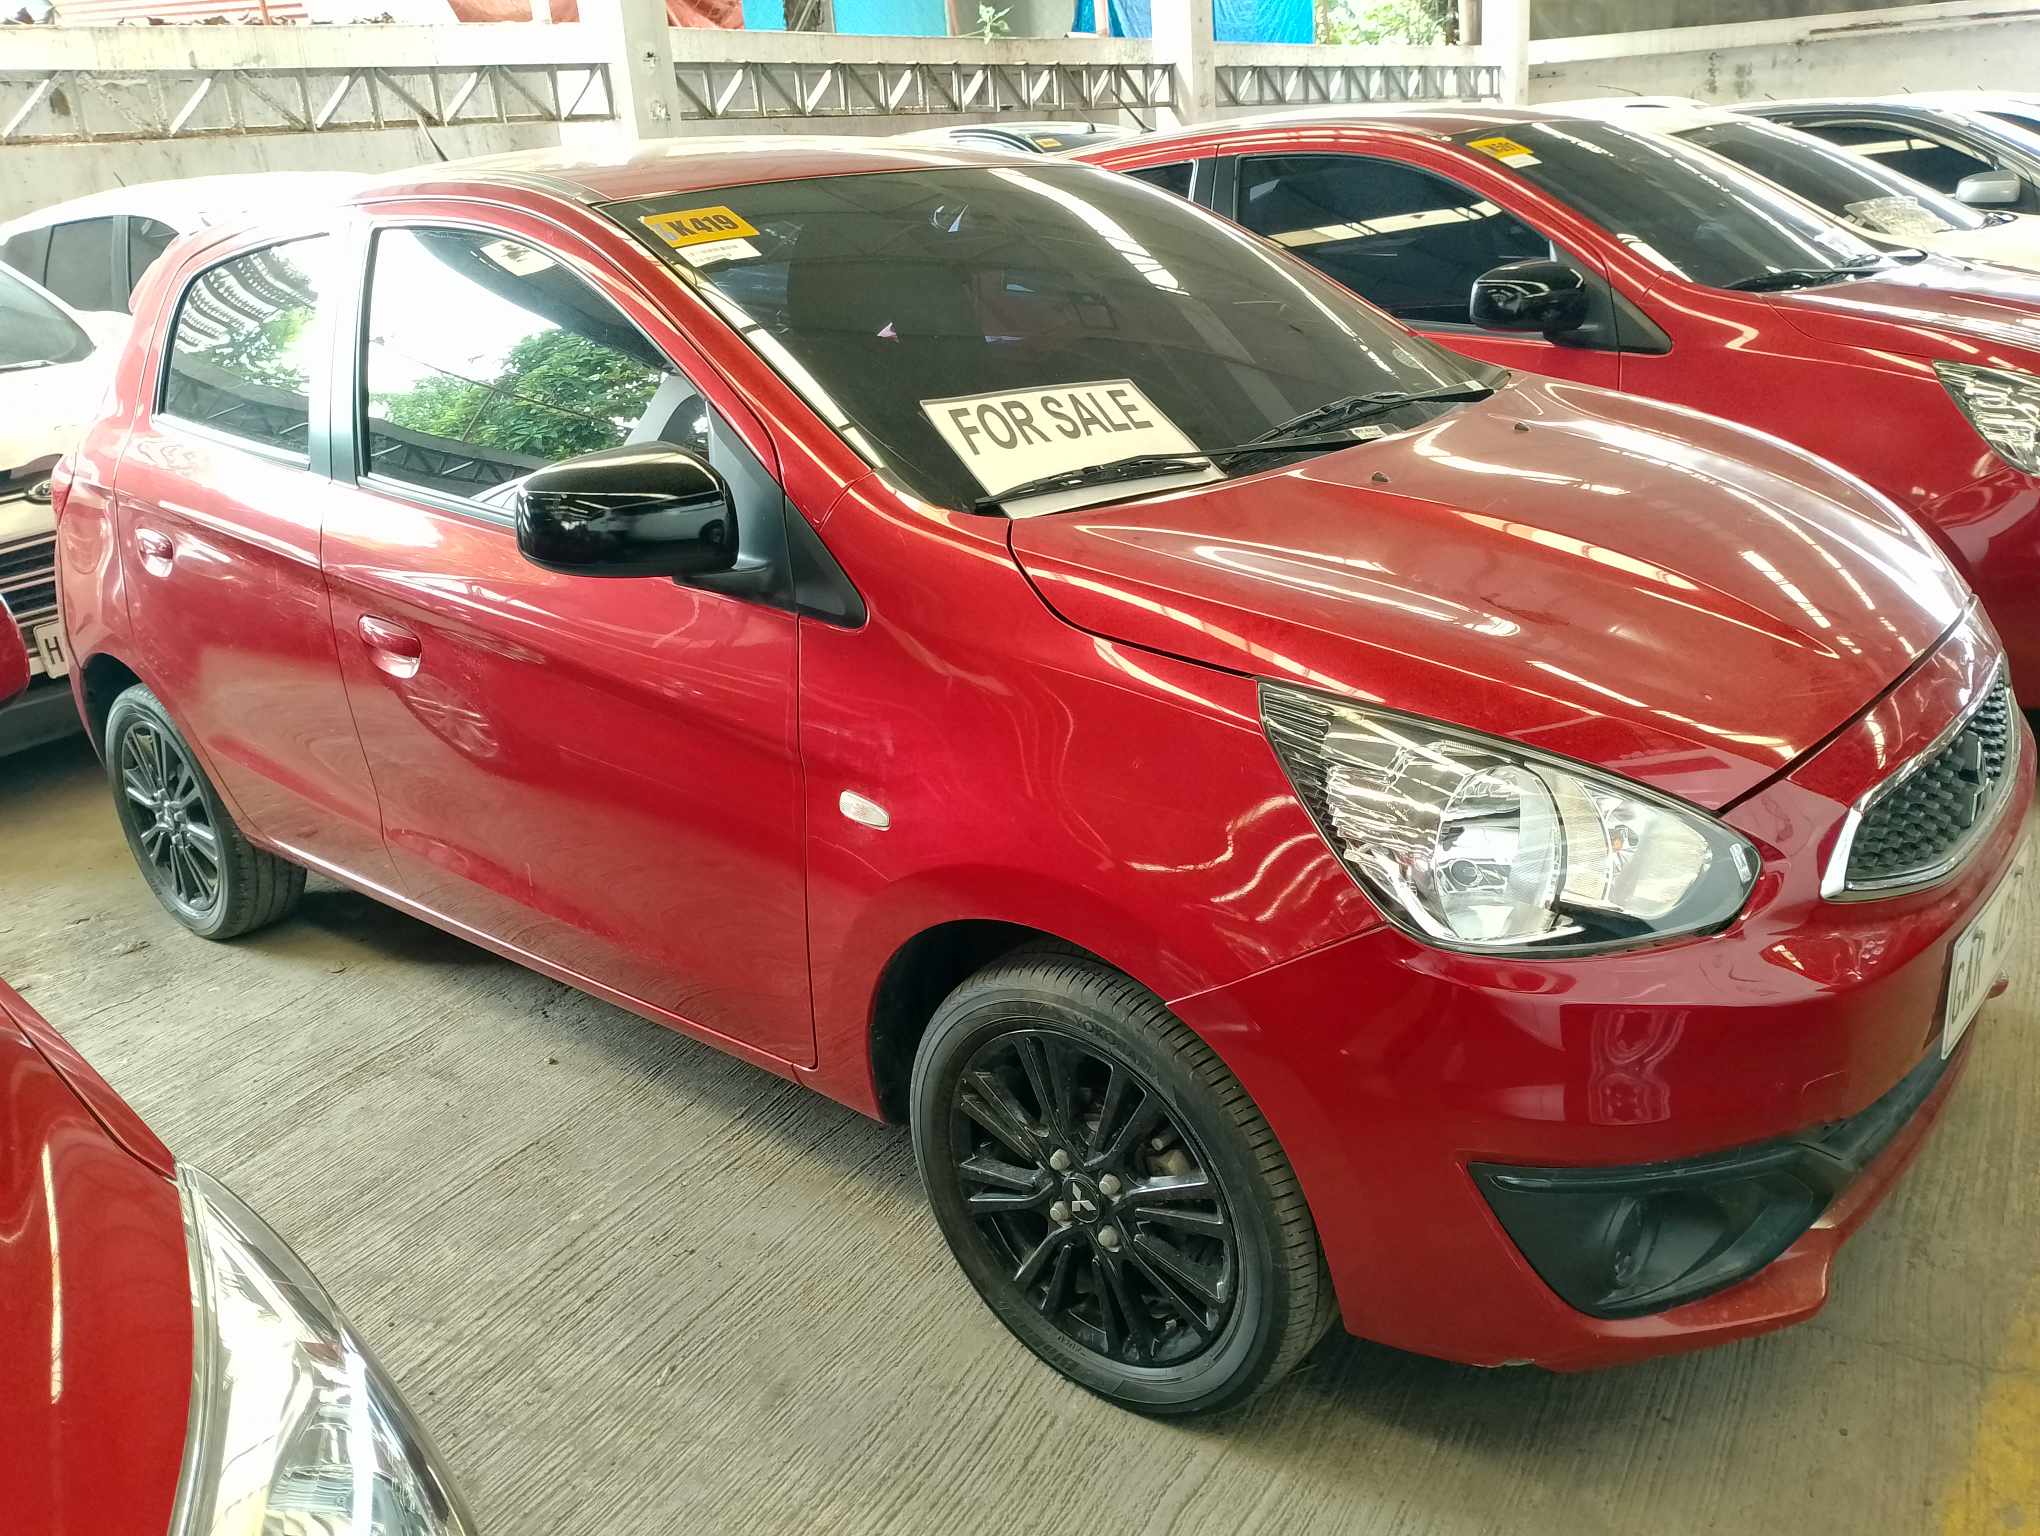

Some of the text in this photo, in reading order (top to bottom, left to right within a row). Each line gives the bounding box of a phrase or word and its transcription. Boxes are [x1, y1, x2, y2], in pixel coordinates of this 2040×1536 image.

[665, 214, 739, 237] K419
[947, 389, 1154, 455] FOR SALE
